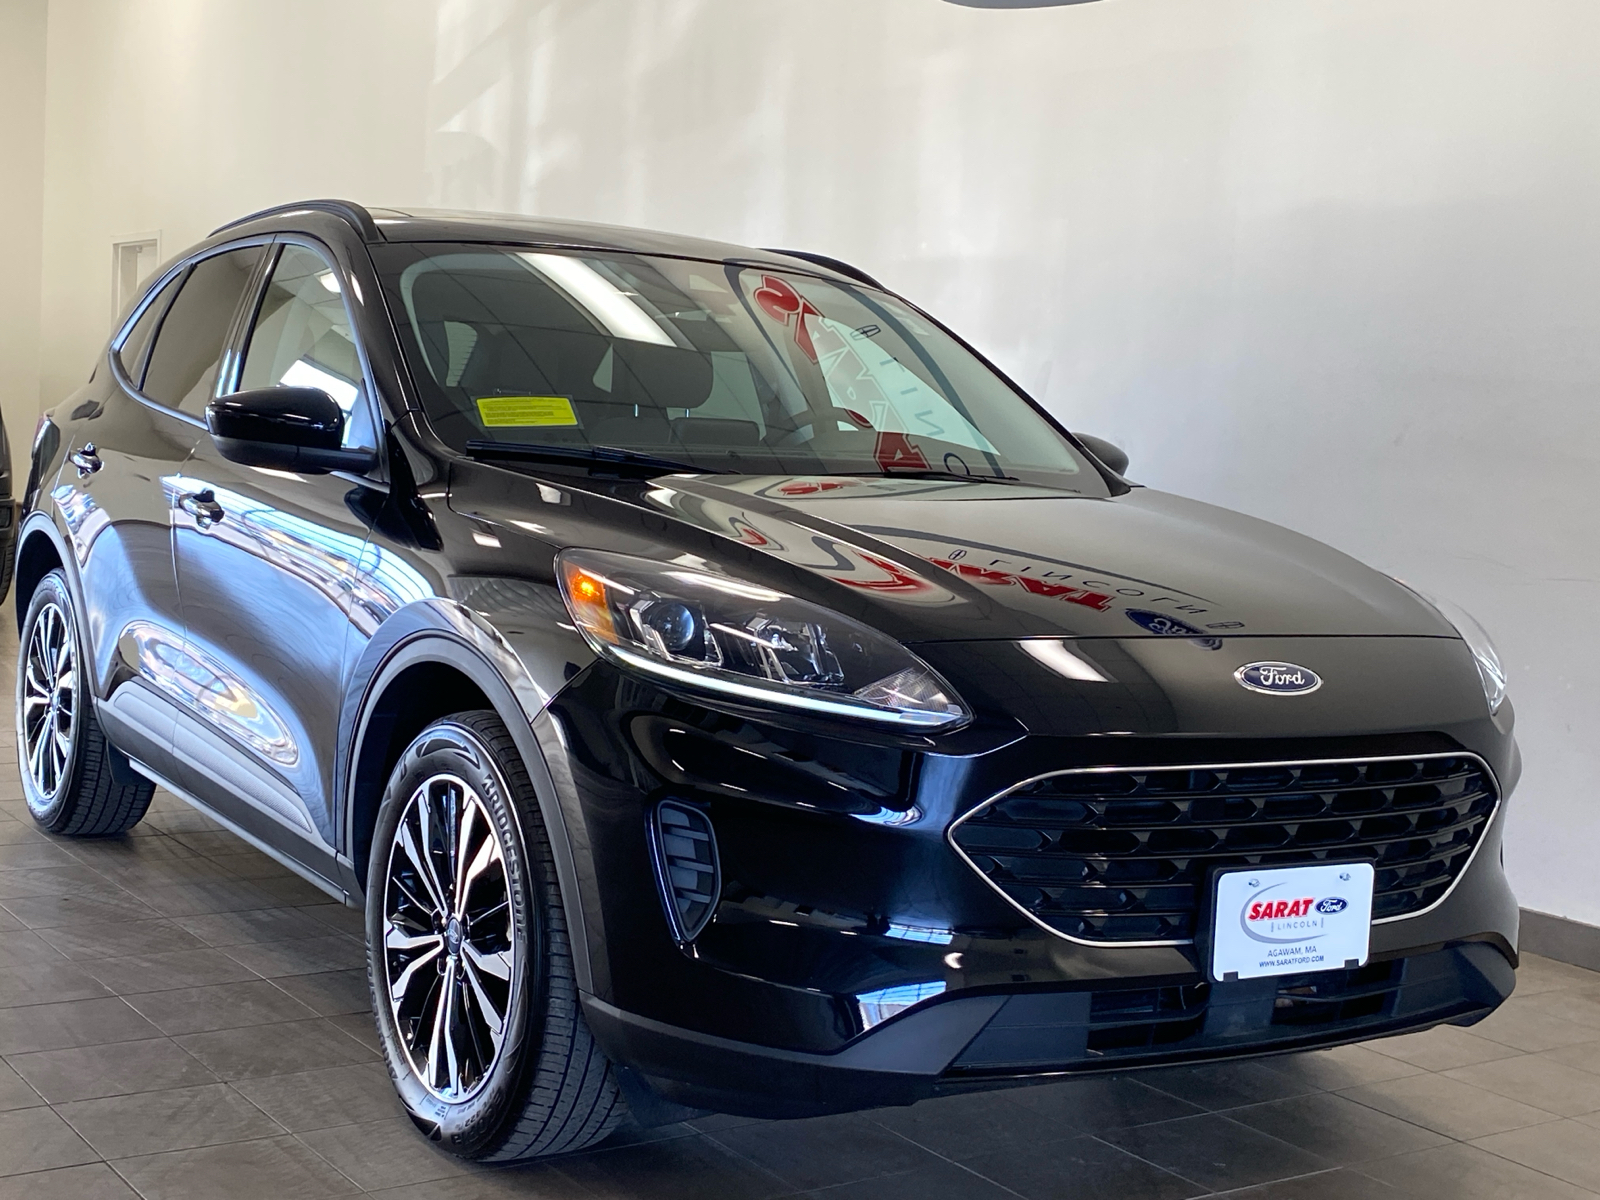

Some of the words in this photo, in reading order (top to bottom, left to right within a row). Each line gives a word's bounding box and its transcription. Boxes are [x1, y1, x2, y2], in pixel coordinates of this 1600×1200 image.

[1259, 666, 1305, 686] Ford
[480, 773, 528, 945] BRIDGESTONE
[1247, 897, 1315, 922] SARAT
[1320, 898, 1344, 913] Ford
[1277, 920, 1318, 931] LINCOLN
[1267, 947, 1304, 957] AGAWAM,
[1305, 945, 1317, 954] MA
[1258, 955, 1325, 968] WWW.SARATFORD.COM
